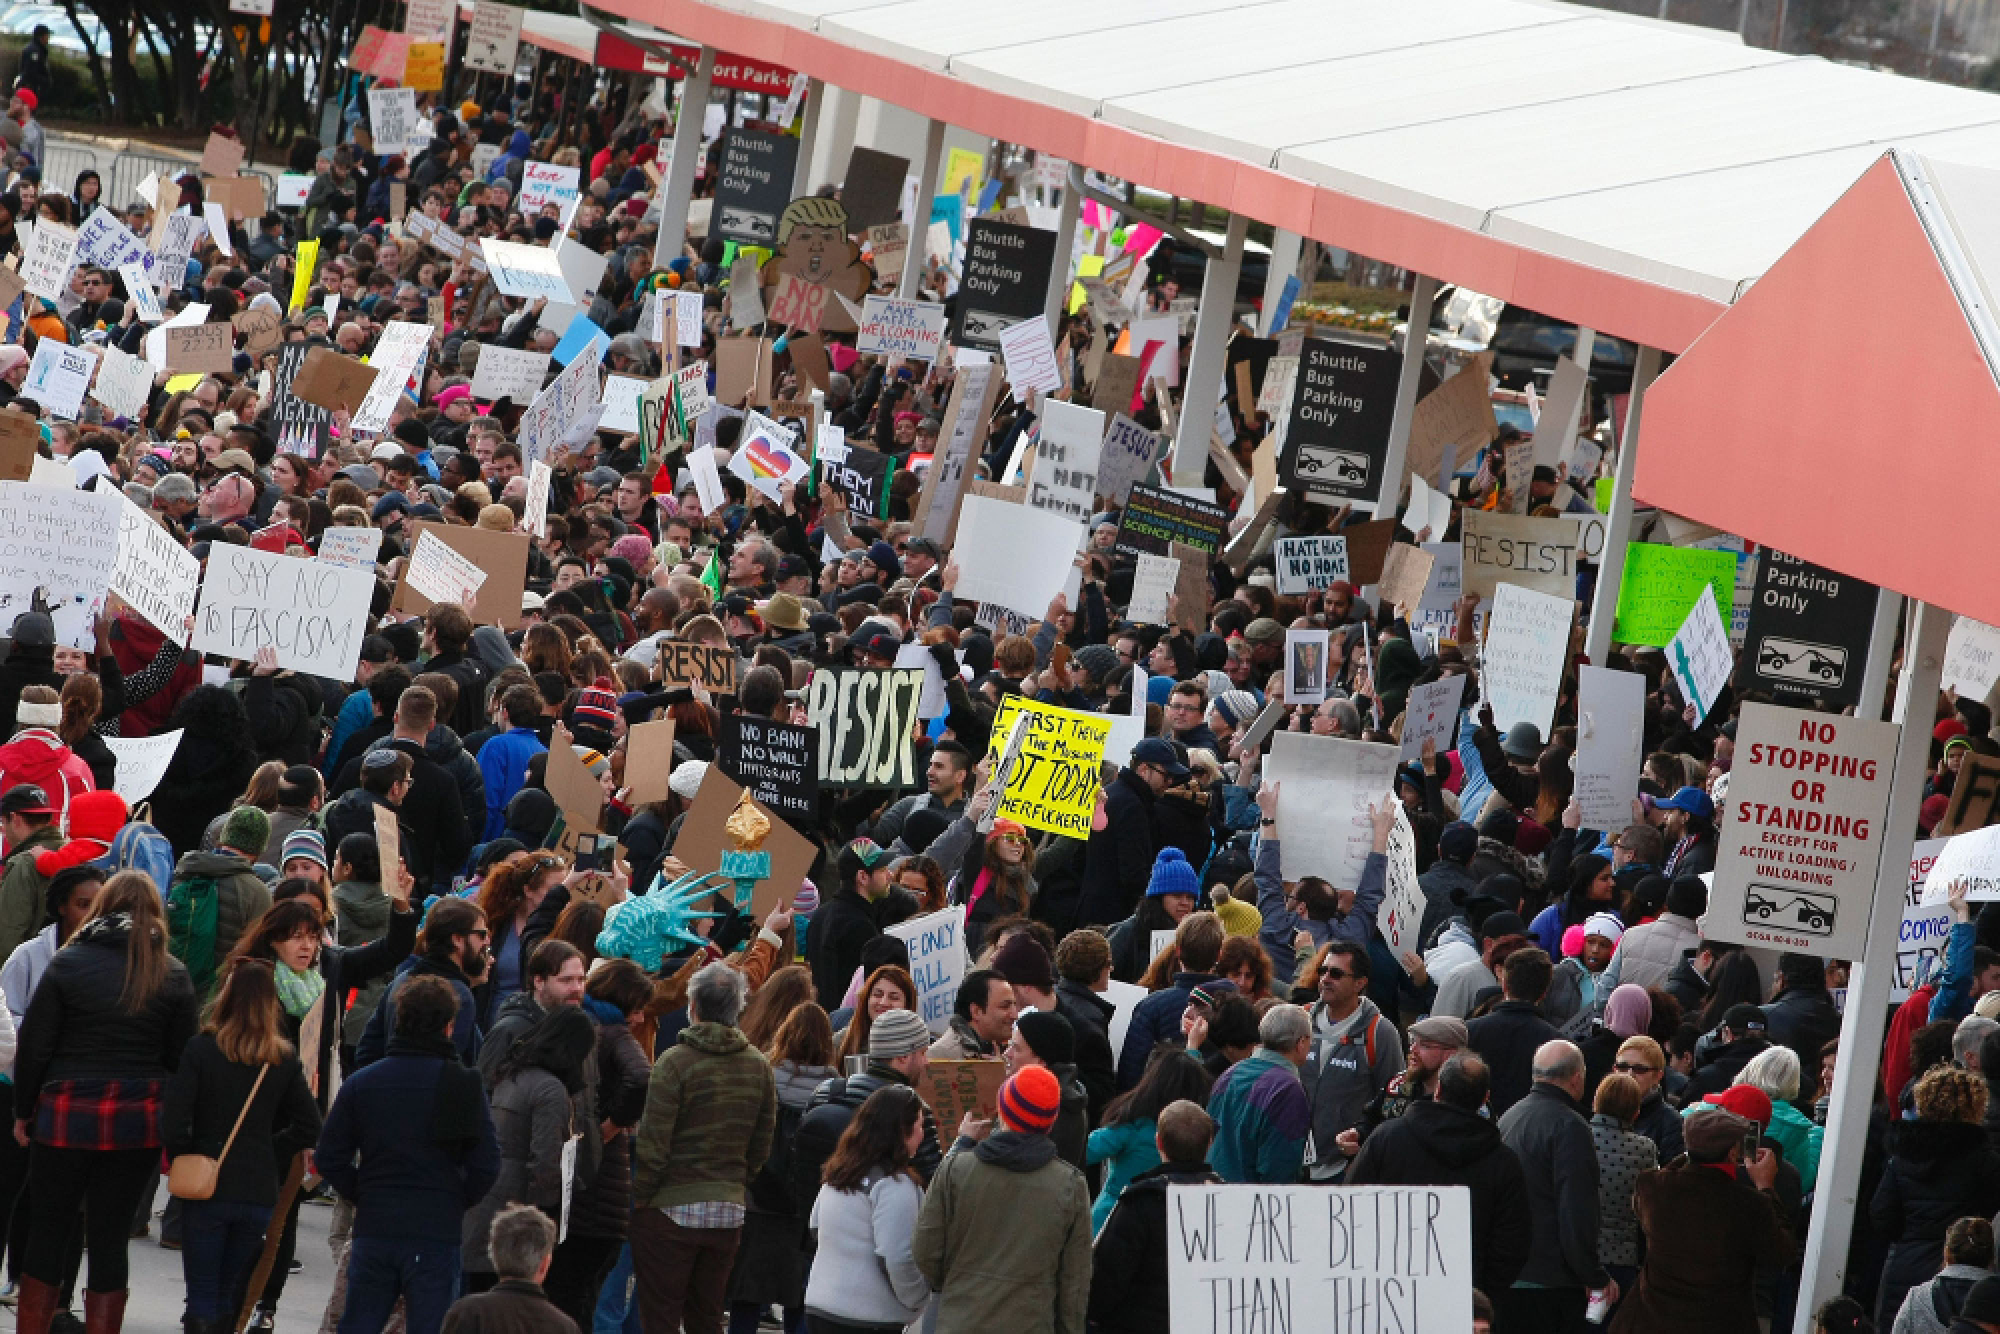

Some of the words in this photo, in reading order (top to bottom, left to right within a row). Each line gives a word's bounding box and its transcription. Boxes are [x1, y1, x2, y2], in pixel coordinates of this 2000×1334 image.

[727, 150, 749, 163] Bus
[730, 135, 773, 153] Shuttle
[526, 163, 565, 182] Love
[723, 177, 751, 193] Only
[725, 164, 771, 183] Parking
[99, 233, 131, 267] EOPLE
[975, 229, 1025, 249] Shuttle
[973, 245, 997, 261] Bus
[969, 261, 1022, 283] Parking
[788, 277, 825, 307] NO
[967, 277, 1000, 296] Only
[769, 295, 825, 333] BAN
[871, 313, 927, 328] AMERICA
[884, 305, 917, 316] MAKE
[171, 325, 224, 339] EXODUS
[861, 322, 939, 343] WELCOMING
[878, 339, 917, 351] AGAIN
[1310, 351, 1367, 372] Shuttle
[1306, 369, 1334, 386] Bus
[1303, 387, 1363, 412] Parking
[273, 402, 328, 423] AGAIN
[1300, 405, 1338, 426] Only
[1111, 421, 1156, 463] JESUS
[826, 461, 873, 497] THEM
[1053, 467, 1097, 492] NOT
[849, 493, 874, 516] IN
[1124, 519, 1171, 541] SCIENCE
[1174, 532, 1185, 544] IS
[1188, 537, 1216, 555] REAL
[1283, 539, 1320, 558] HATE
[1321, 538, 1343, 554] HAS
[1463, 532, 1576, 577] RESIST
[127, 544, 171, 596] Hands
[1289, 559, 1310, 577] NO
[1313, 558, 1346, 575] HOME
[228, 553, 278, 601] SAY
[294, 567, 341, 609] NO
[1767, 567, 1839, 598] Parking
[115, 572, 186, 640] ONSTITUTION
[1763, 591, 1808, 615] Only
[231, 606, 354, 669] FASCISM
[661, 642, 735, 689] RESIST
[1002, 692, 1066, 734] FRST
[740, 723, 762, 741] NO
[767, 727, 806, 750] BAN!
[808, 669, 925, 785] RESIST
[1798, 719, 1836, 744] NO
[1027, 733, 1049, 752] THE
[742, 745, 765, 761] NO
[769, 750, 809, 767] WALL!
[1749, 743, 1877, 781] STOPPING
[738, 762, 801, 784] IMMIGRANTS
[753, 789, 779, 805] COME
[784, 795, 809, 811] HERE
[1791, 779, 1826, 804] OR
[999, 795, 1091, 835] HERFUCKER!!
[1737, 801, 1869, 840] STANDING
[1761, 831, 1809, 849] EXCEPT
[1813, 838, 1839, 853] FOR
[1739, 845, 1785, 863] ACTIVE
[1788, 852, 1847, 873] LOADING
[1755, 863, 1833, 887] UNLOADING
[921, 920, 957, 955] ONLY
[1899, 915, 1950, 943] come
[914, 959, 951, 997] ALL
[1177, 1191, 1225, 1263] WE
[1246, 1191, 1301, 1264] ARE
[1328, 1189, 1447, 1277] BETTER
[1200, 1276, 1292, 1334] THAN
